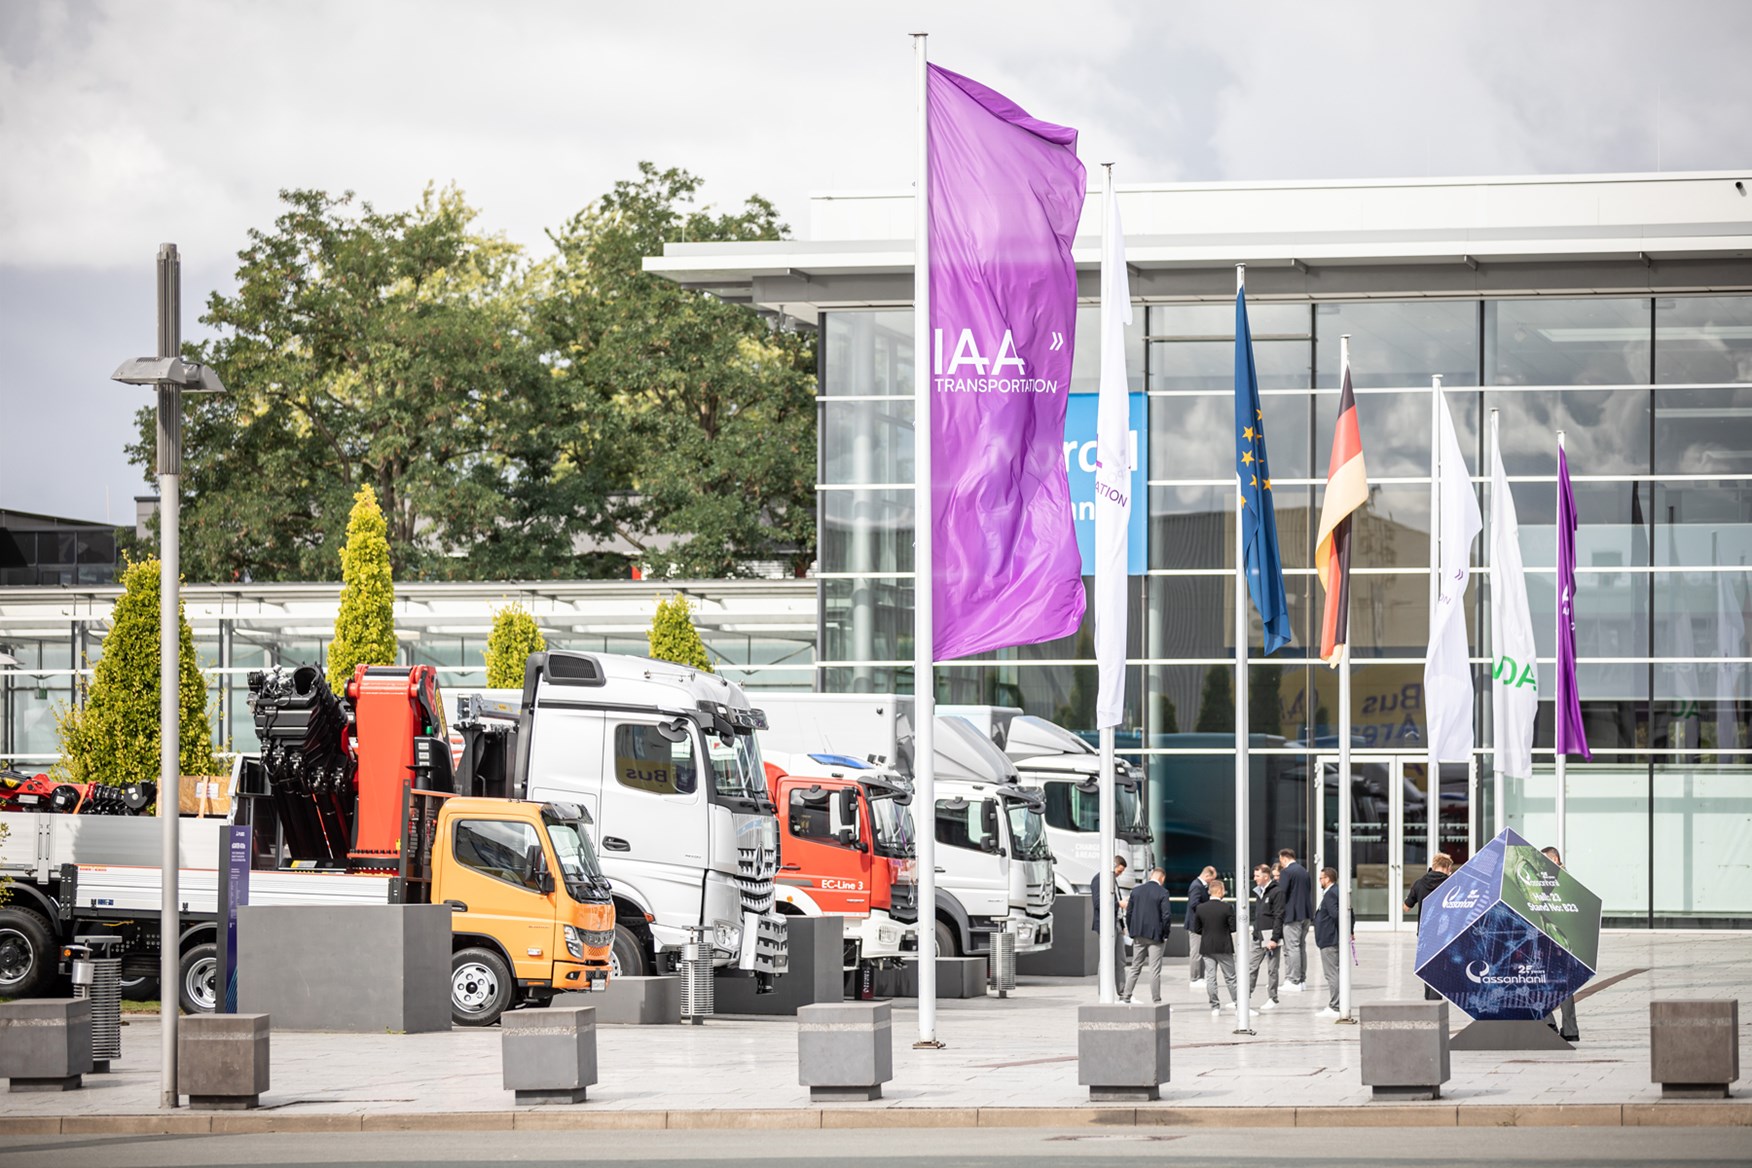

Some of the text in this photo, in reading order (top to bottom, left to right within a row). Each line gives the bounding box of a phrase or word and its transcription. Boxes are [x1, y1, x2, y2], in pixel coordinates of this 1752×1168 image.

[934, 328, 1025, 376] IAA
[934, 378, 1057, 394] TRANSPORTATION
[821, 879, 864, 891] EC-Line 3
